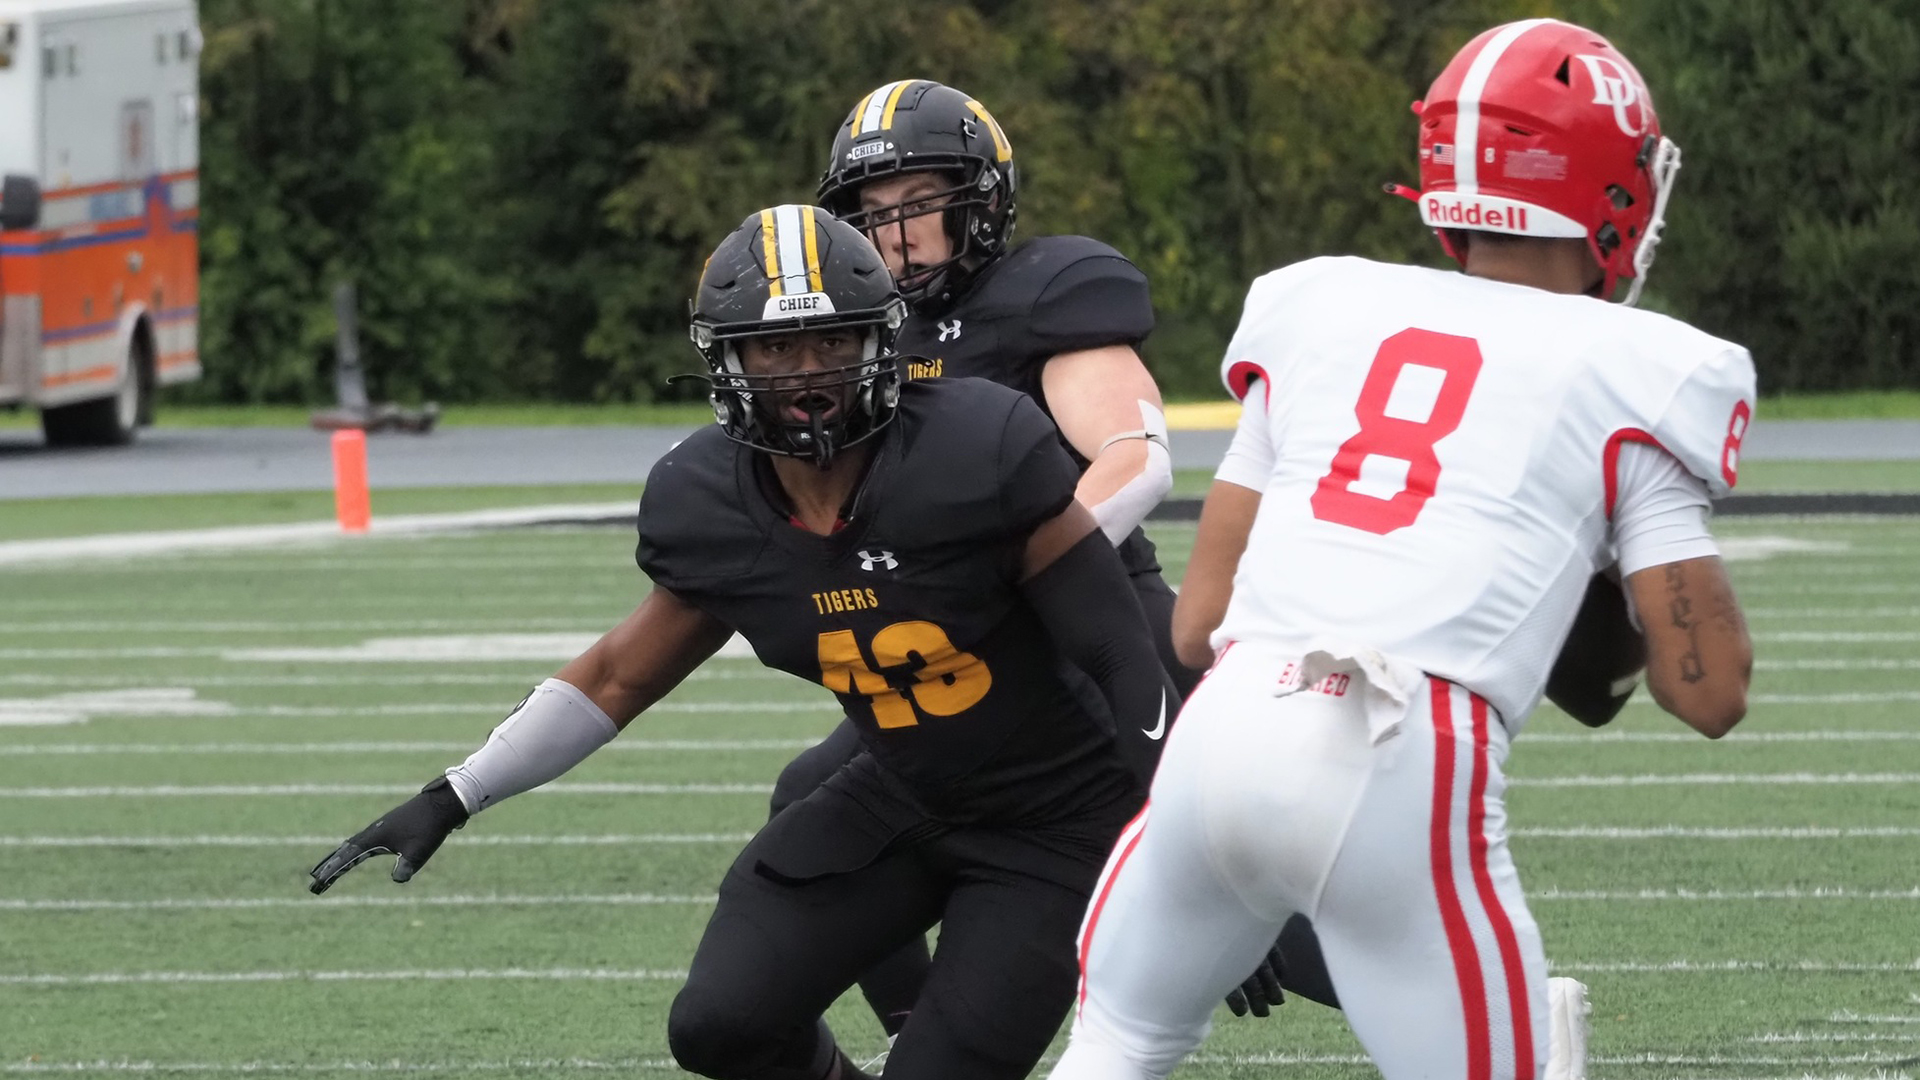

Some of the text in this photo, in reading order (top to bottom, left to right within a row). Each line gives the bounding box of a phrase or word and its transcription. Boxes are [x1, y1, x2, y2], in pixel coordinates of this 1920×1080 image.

[854, 143, 882, 158] CHIEF
[1427, 198, 1528, 231] Riddell
[779, 296, 819, 311] CHIEF
[907, 358, 943, 381] TIGERS
[1310, 327, 1483, 535] 8
[1721, 399, 1750, 488] 8
[812, 588, 878, 614] TIGERS
[818, 620, 993, 729] 43
